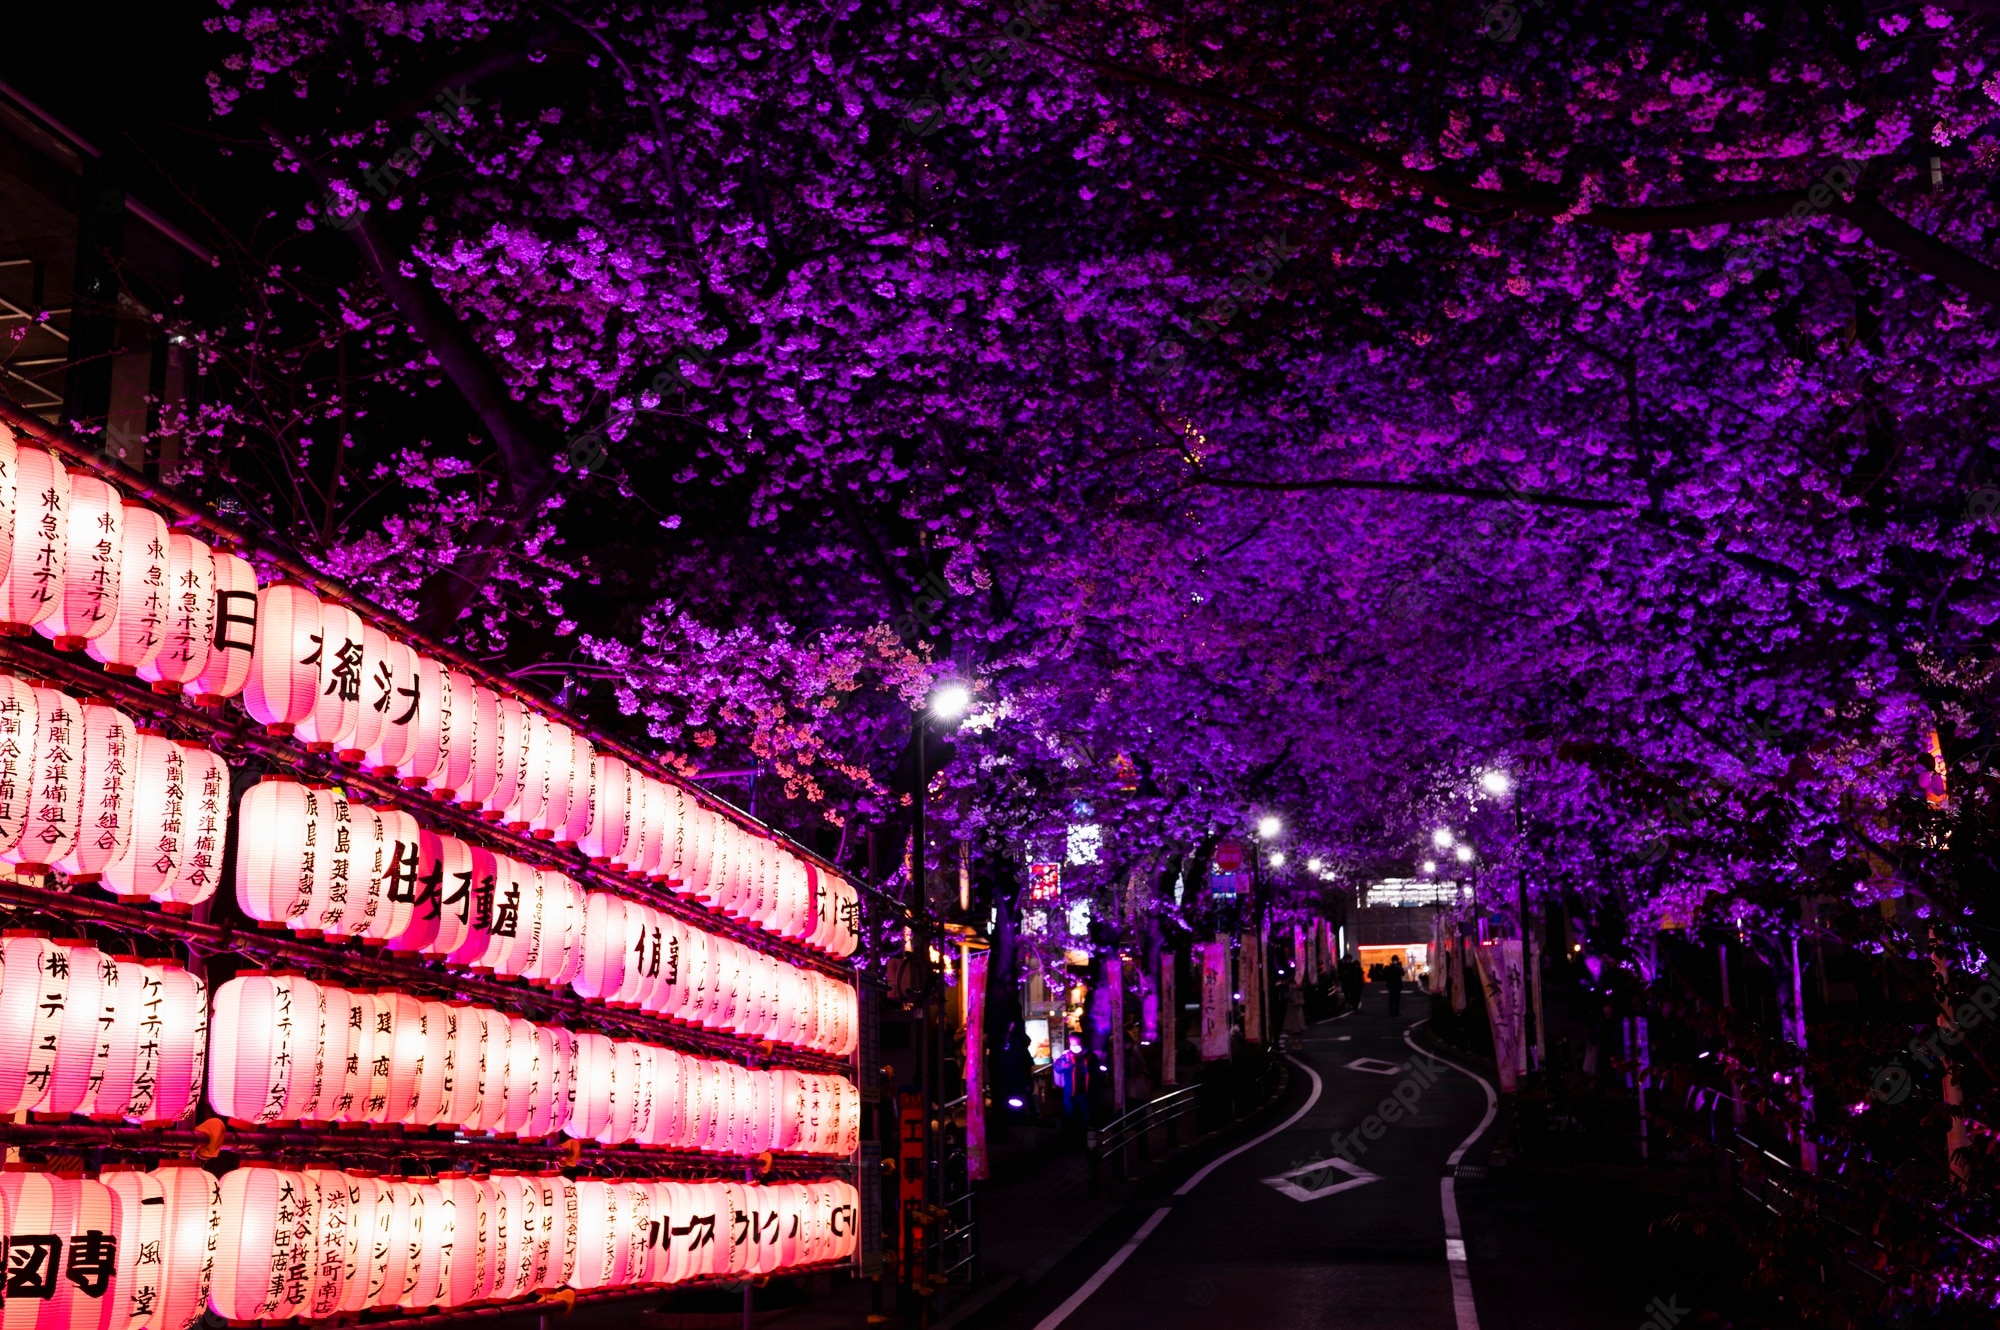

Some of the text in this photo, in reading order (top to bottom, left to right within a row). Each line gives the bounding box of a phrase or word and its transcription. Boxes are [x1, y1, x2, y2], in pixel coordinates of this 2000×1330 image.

[30, 487, 61, 603] 東急ホテル
[83, 512, 115, 621] 東急ホテル
[137, 537, 166, 647] 東急ホテル
[171, 570, 200, 662] 東急ホテル
[37, 709, 72, 843] 再開発準備組合
[94, 725, 127, 849] 再開発準備組合
[153, 751, 184, 873] 再開発準備組合
[187, 767, 223, 886] 再開発準備組合
[0, 1229, 117, 1309] 図専
[129, 1196, 164, 1318] 一風堂
